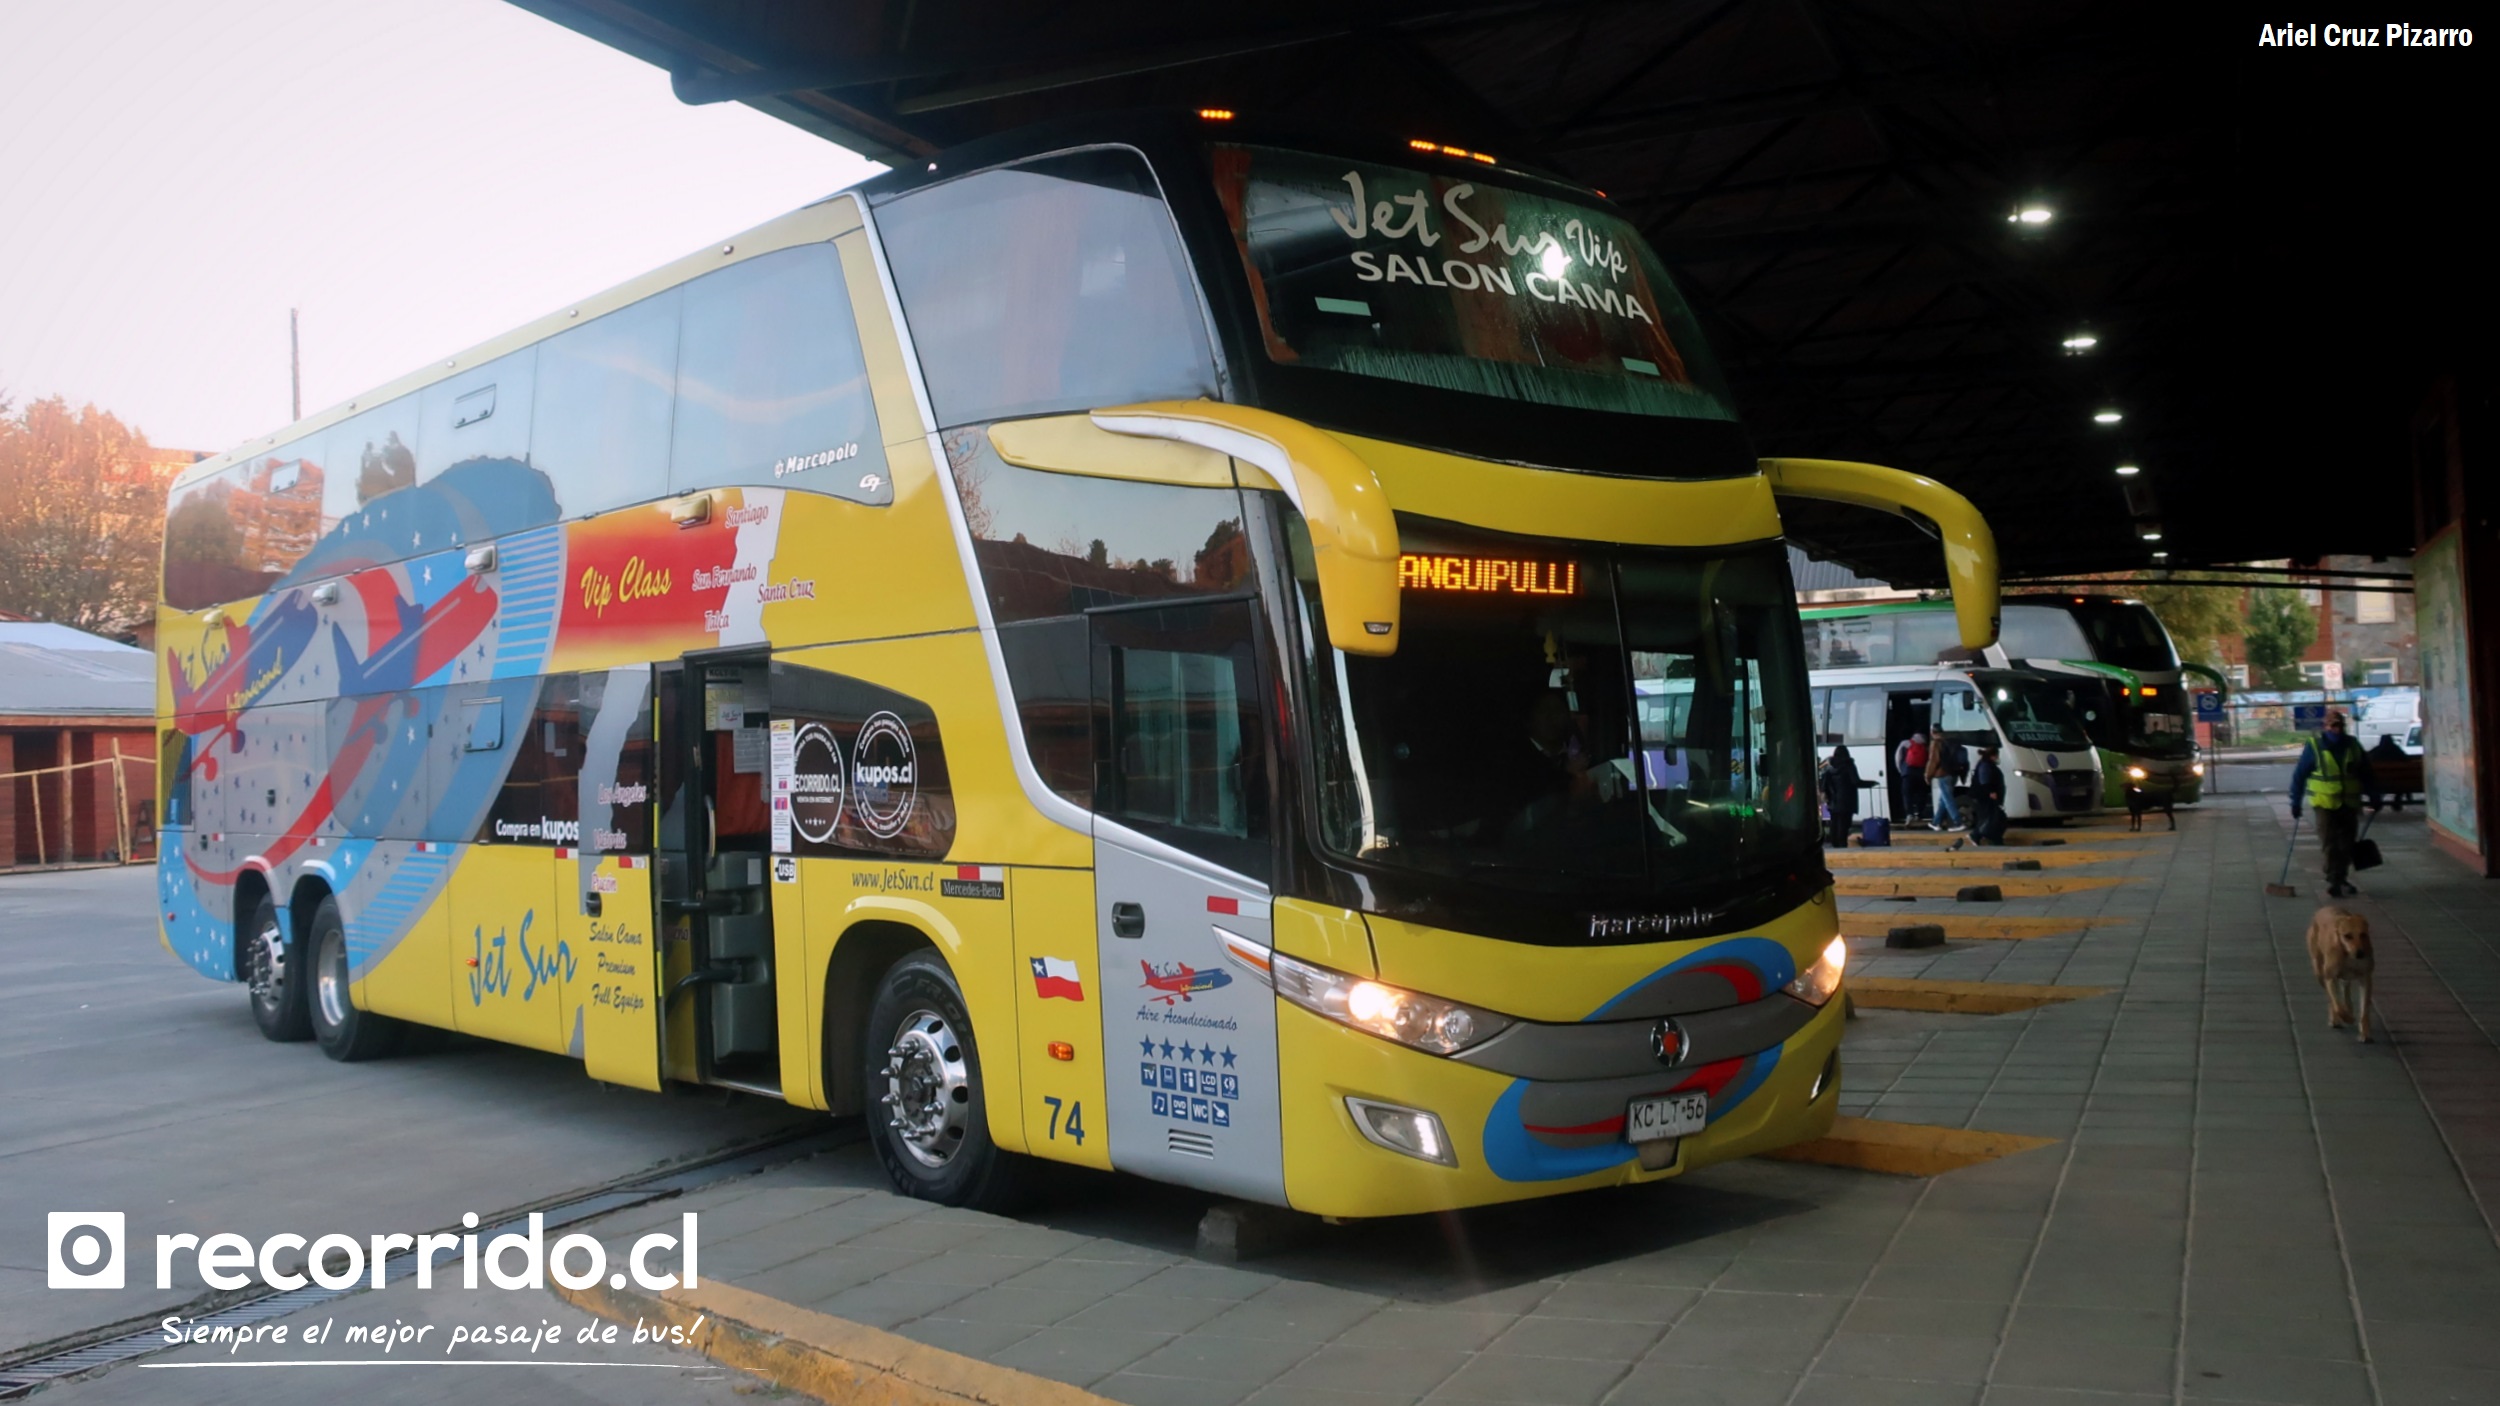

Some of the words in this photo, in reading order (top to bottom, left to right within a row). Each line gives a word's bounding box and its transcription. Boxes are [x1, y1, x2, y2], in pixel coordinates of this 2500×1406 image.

[1330, 171, 1440, 247] Jet
[1565, 219, 1628, 284] Vip
[1350, 251, 1517, 296] SALON
[1525, 272, 1654, 325] CAMA
[785, 442, 858, 474] Marcopolo
[725, 504, 769, 528] Santiago
[580, 565, 613, 619] Vip
[619, 556, 672, 603] Class
[692, 567, 712, 591] San
[712, 563, 757, 589] Fernando
[1398, 555, 1575, 595] ANGUIPULLI
[757, 582, 788, 603] Santa
[789, 577, 815, 600] Cruz
[704, 610, 729, 632] Talca
[795, 773, 841, 792] ECORRIDO.CL
[856, 761, 913, 787] kupos.cl
[599, 783, 613, 805] Los
[495, 819, 528, 841] Compra
[530, 824, 541, 836] en
[541, 815, 579, 845] kupos
[778, 863, 795, 878] USB
[852, 868, 934, 892] www.JetSur.cl
[943, 881, 1003, 898] Mercedes-Benz
[616, 922, 642, 945] Cama
[469, 924, 512, 1007] Jet
[519, 908, 578, 1002] Sur
[597, 952, 635, 976] Premium
[592, 983, 611, 1006] Full
[613, 986, 644, 1014] Equipo
[1136, 1004, 1160, 1022] Aire
[1163, 1007, 1238, 1031] Acondicionado
[1143, 1068, 1155, 1080] TV
[1201, 1074, 1216, 1086] LCD
[1044, 1095, 1085, 1146] 74
[1173, 1099, 1187, 1110] DVD
[1193, 1103, 1208, 1119] WC
